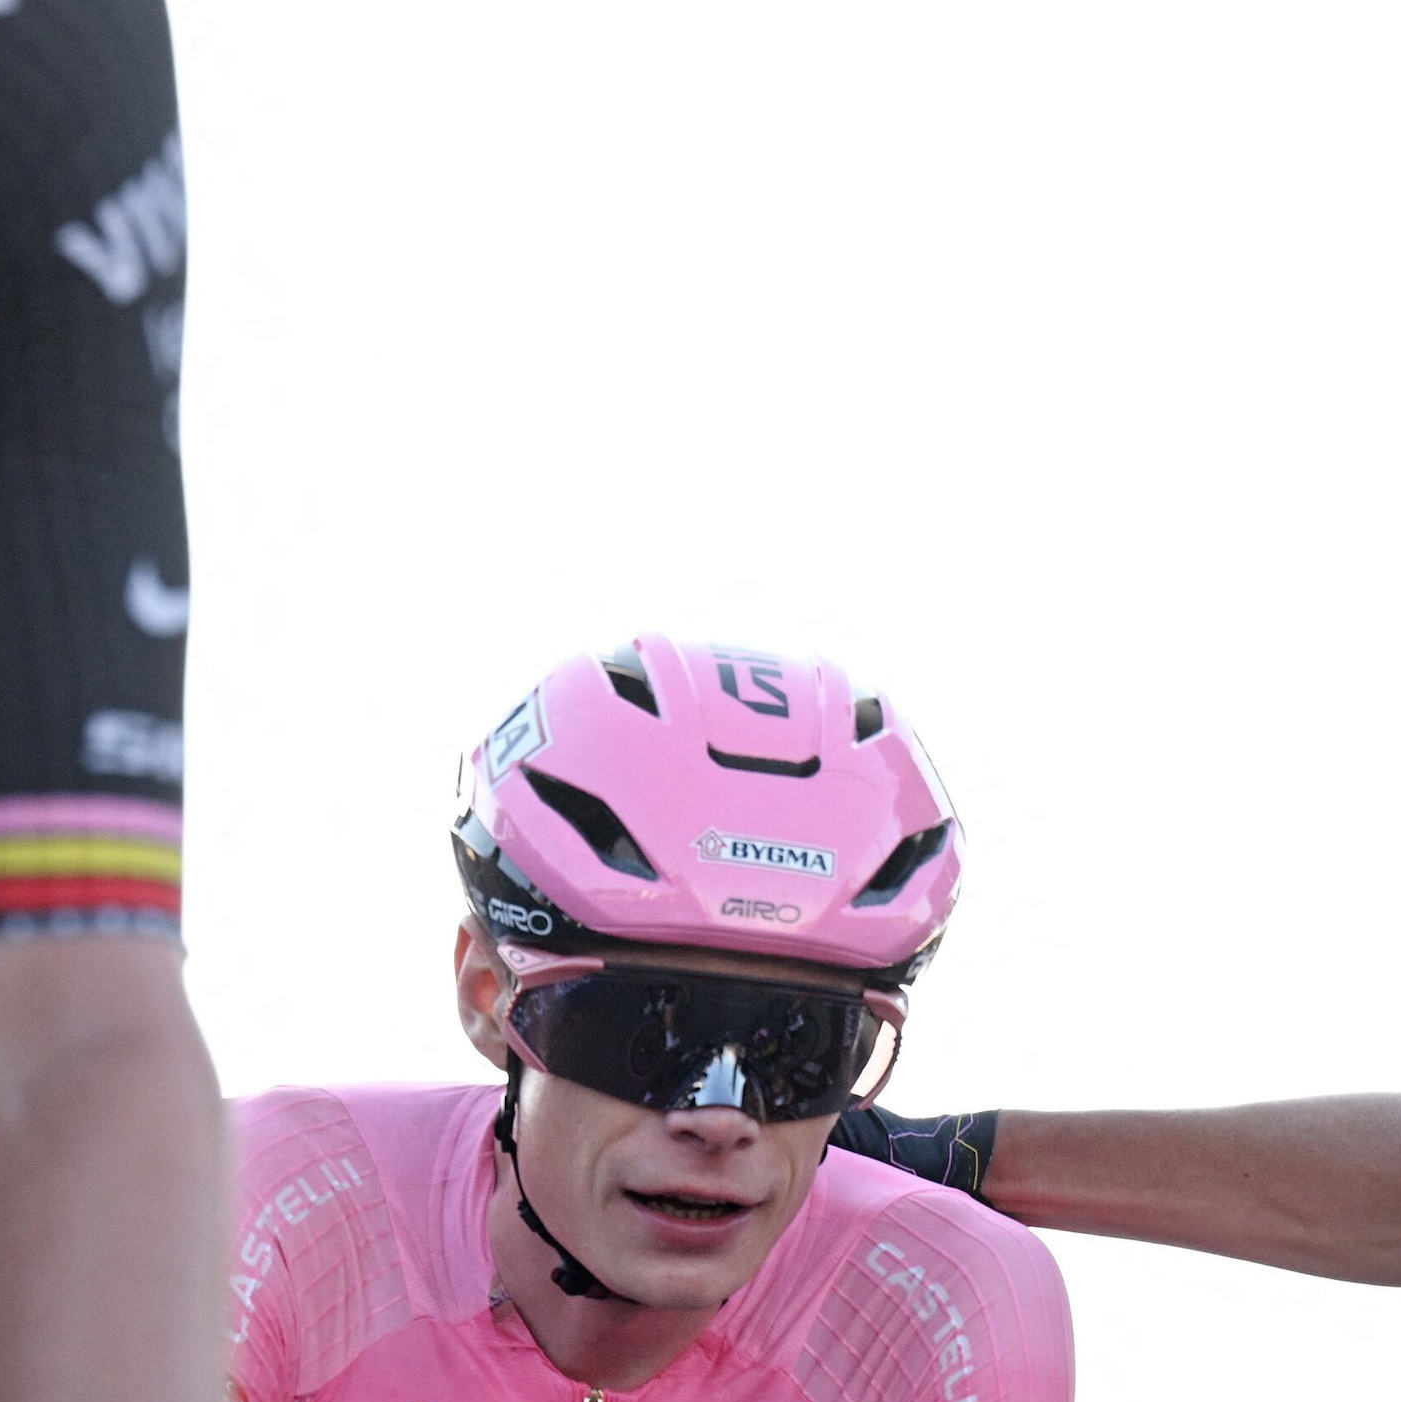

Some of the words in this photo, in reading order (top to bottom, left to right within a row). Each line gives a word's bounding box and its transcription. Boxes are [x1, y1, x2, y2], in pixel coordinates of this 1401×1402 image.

[730, 840, 829, 874] BYGMA
[486, 898, 554, 937] GIRO
[719, 898, 802, 925] GIRO
